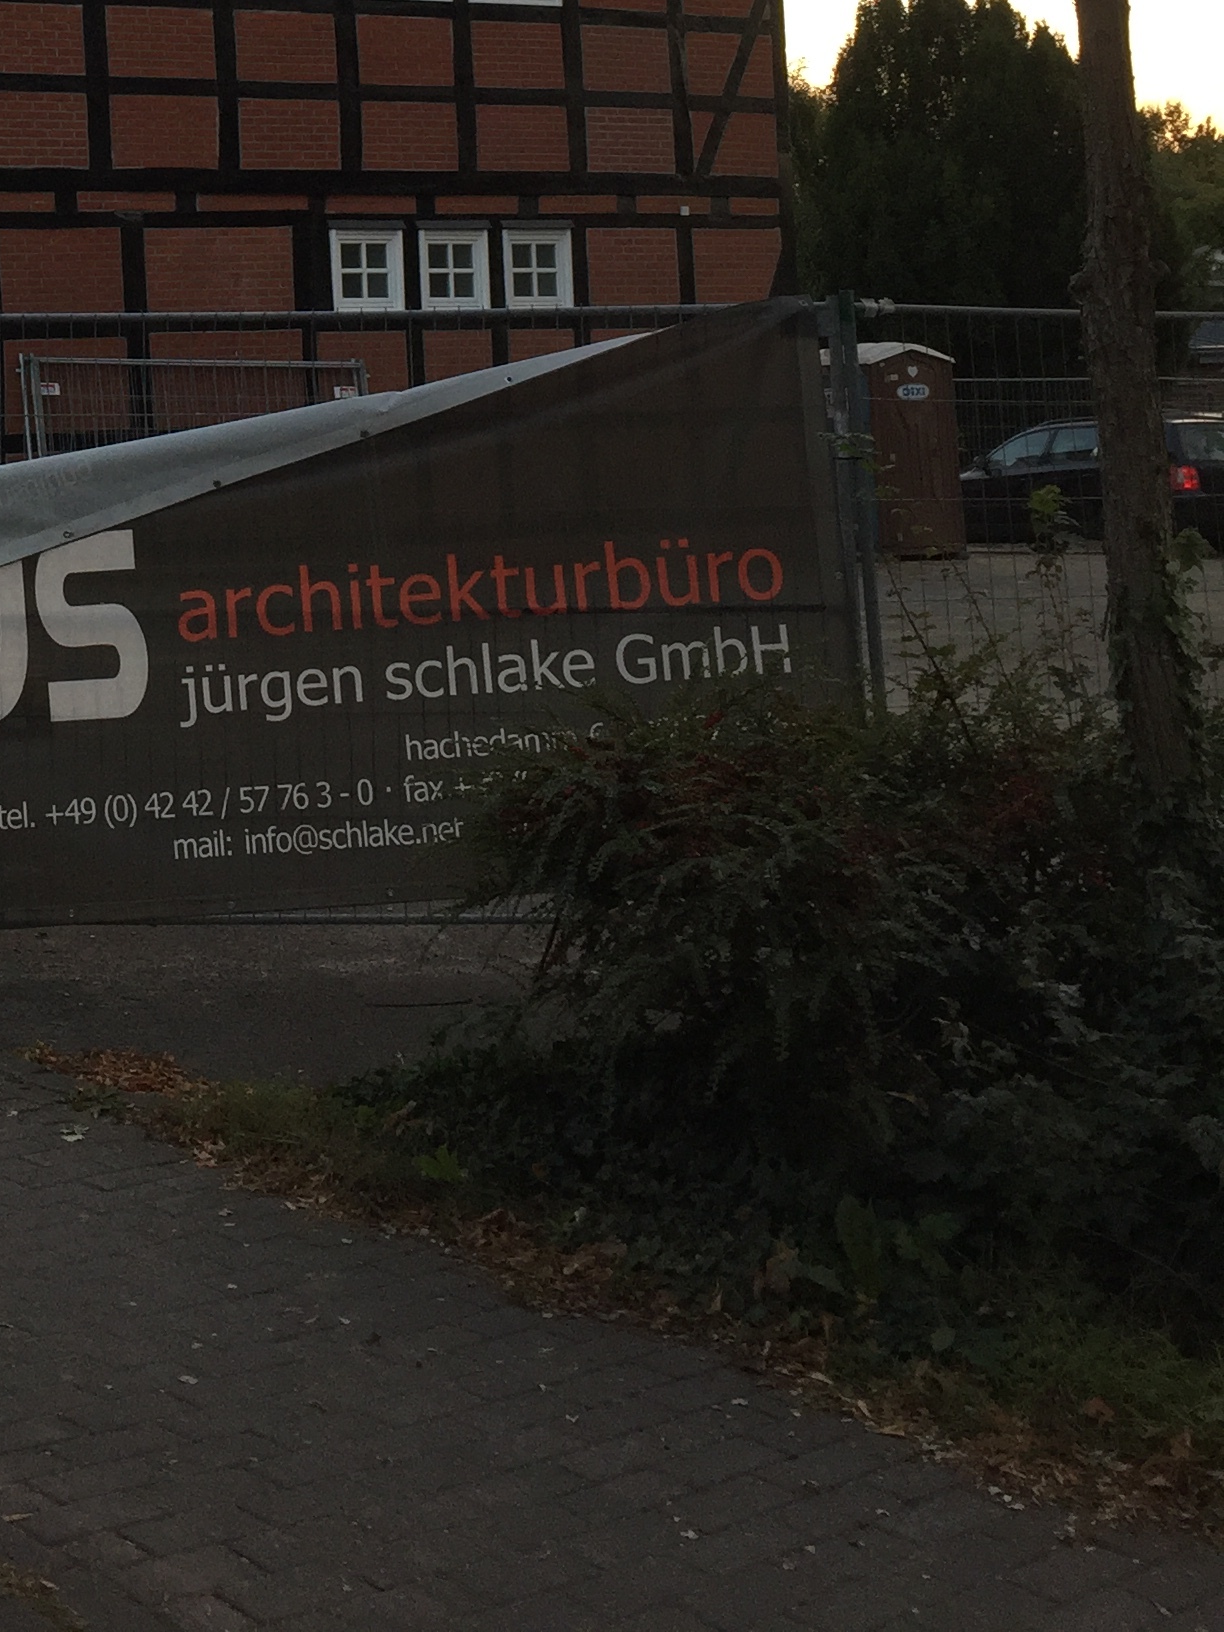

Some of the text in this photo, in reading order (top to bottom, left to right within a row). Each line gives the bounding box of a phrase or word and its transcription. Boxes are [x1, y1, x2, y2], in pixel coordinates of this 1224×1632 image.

[177, 538, 784, 643] architekturbüro
[179, 623, 792, 728] jürgen schlake GmbH
[45, 796, 97, 826] +49
[104, 793, 138, 830] (0)
[144, 791, 176, 819] 42
[182, 789, 214, 817] 42
[239, 785, 270, 814] 57
[277, 782, 310, 810] 76
[316, 780, 332, 808] 3
[357, 778, 374, 806] 0
[403, 774, 444, 802] fax
[173, 828, 233, 860] mail:
